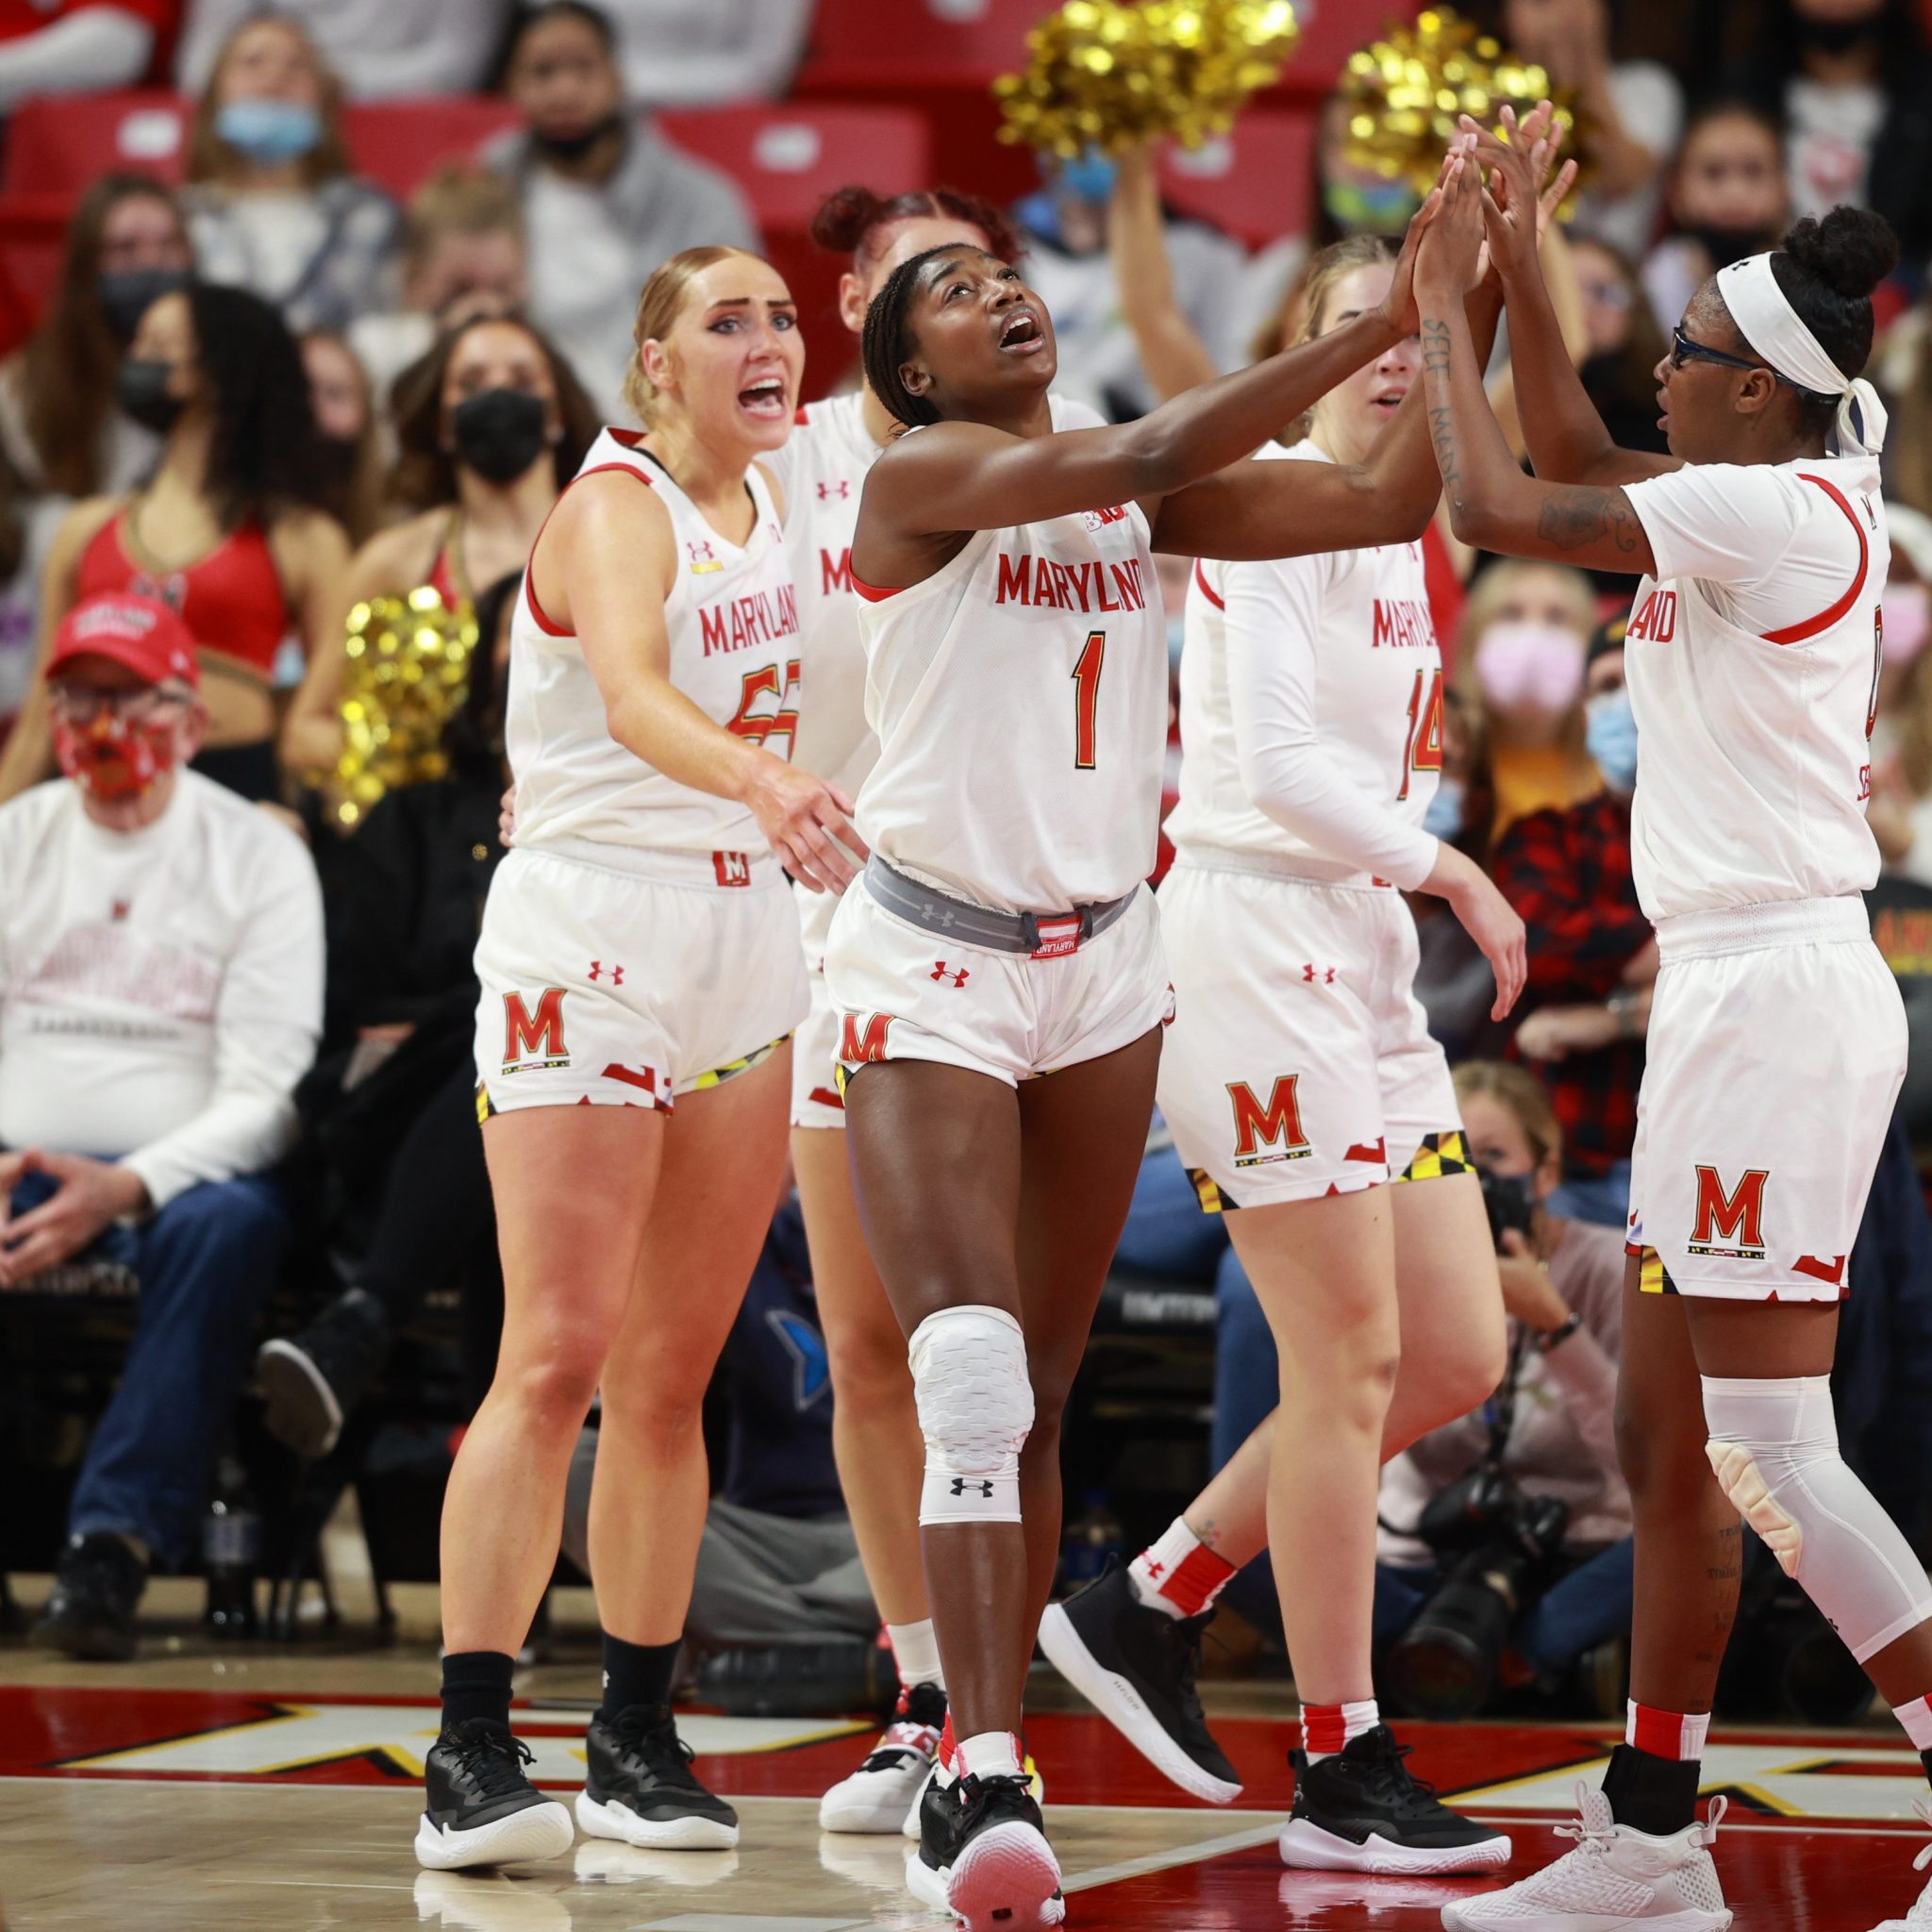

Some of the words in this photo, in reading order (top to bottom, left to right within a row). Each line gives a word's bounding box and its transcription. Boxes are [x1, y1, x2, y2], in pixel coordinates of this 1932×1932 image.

[698, 584, 800, 658] MARYLAN
[1071, 630, 1106, 770] 1
[1397, 668, 1443, 801] 14
[502, 988, 571, 1064] M
[840, 1012, 895, 1063] M
[1225, 1074, 1310, 1157] M
[1689, 1164, 1770, 1248] M
